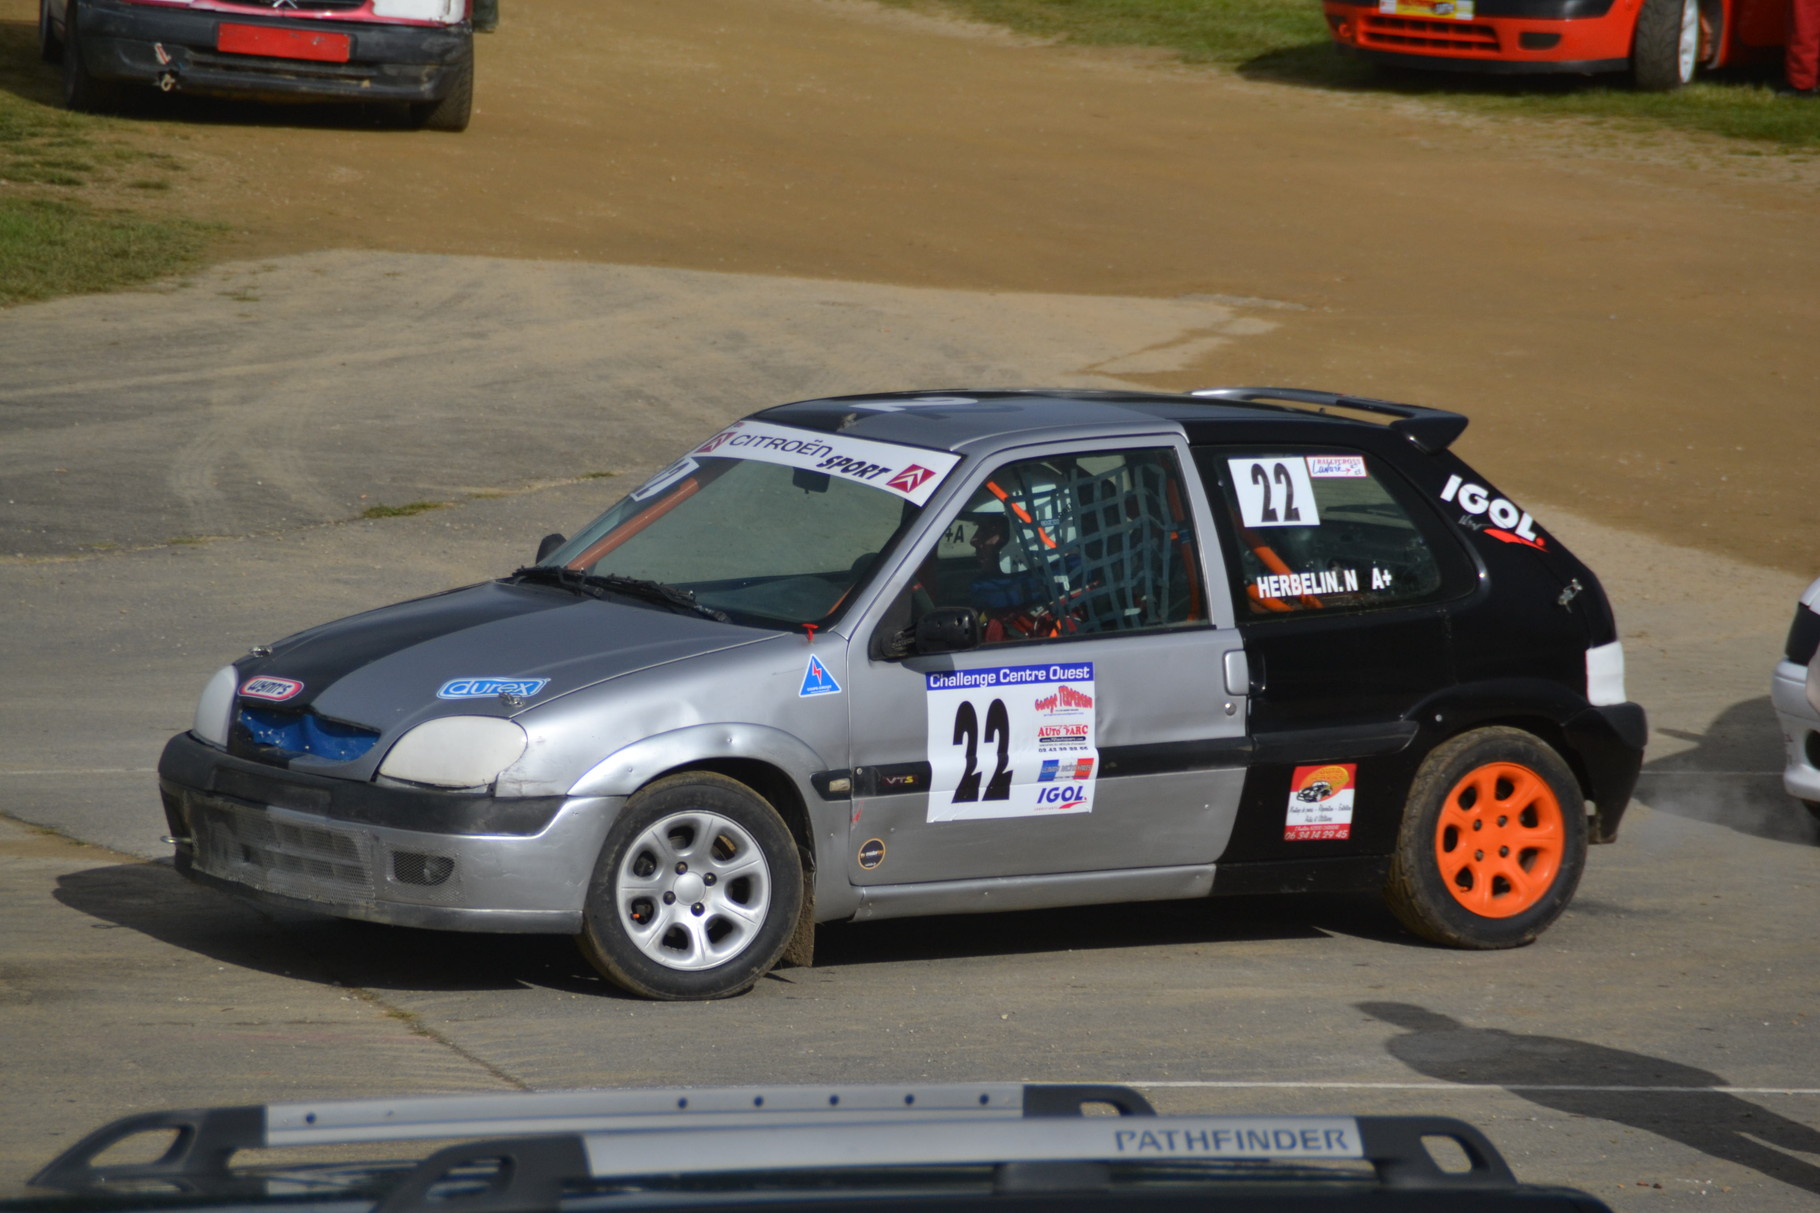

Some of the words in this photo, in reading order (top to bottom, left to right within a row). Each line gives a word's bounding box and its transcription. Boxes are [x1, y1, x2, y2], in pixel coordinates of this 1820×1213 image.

[815, 454, 893, 481] SPORT
[1250, 462, 1301, 523] 22
[1440, 474, 1537, 542] IGOL
[1371, 567, 1393, 591] A+
[449, 680, 538, 697] durex
[929, 671, 997, 689] Challenge
[999, 667, 1047, 684] Centre
[1049, 664, 1091, 680] Ouest
[1038, 726, 1061, 737] AUTO
[951, 698, 1014, 804] 22
[886, 775, 914, 785] VTS
[1036, 785, 1084, 804] IGOL
[1114, 1128, 1350, 1152] PATHFINDER
